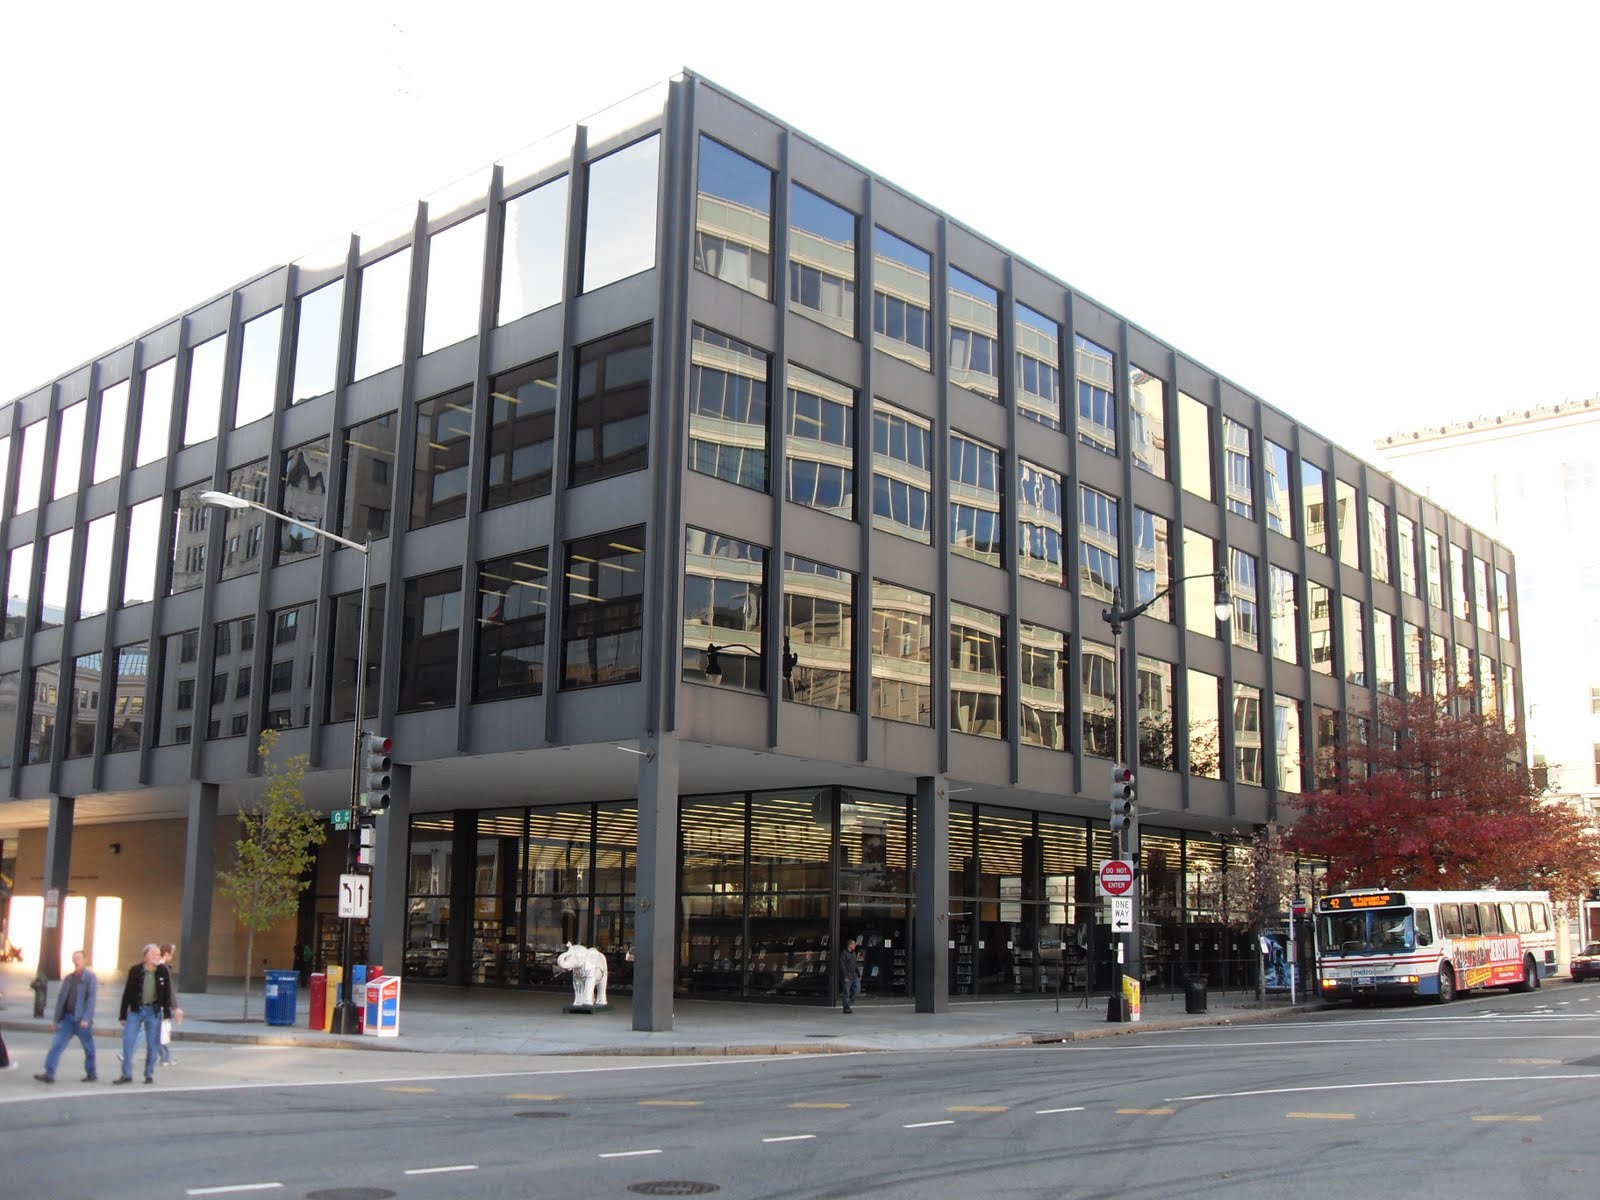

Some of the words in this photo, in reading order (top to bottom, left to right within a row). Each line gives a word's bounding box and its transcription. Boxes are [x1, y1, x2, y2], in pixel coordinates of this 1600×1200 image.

[335, 812, 341, 822] G
[1115, 900, 1129, 908] ONE
[1330, 898, 1340, 908] 42
